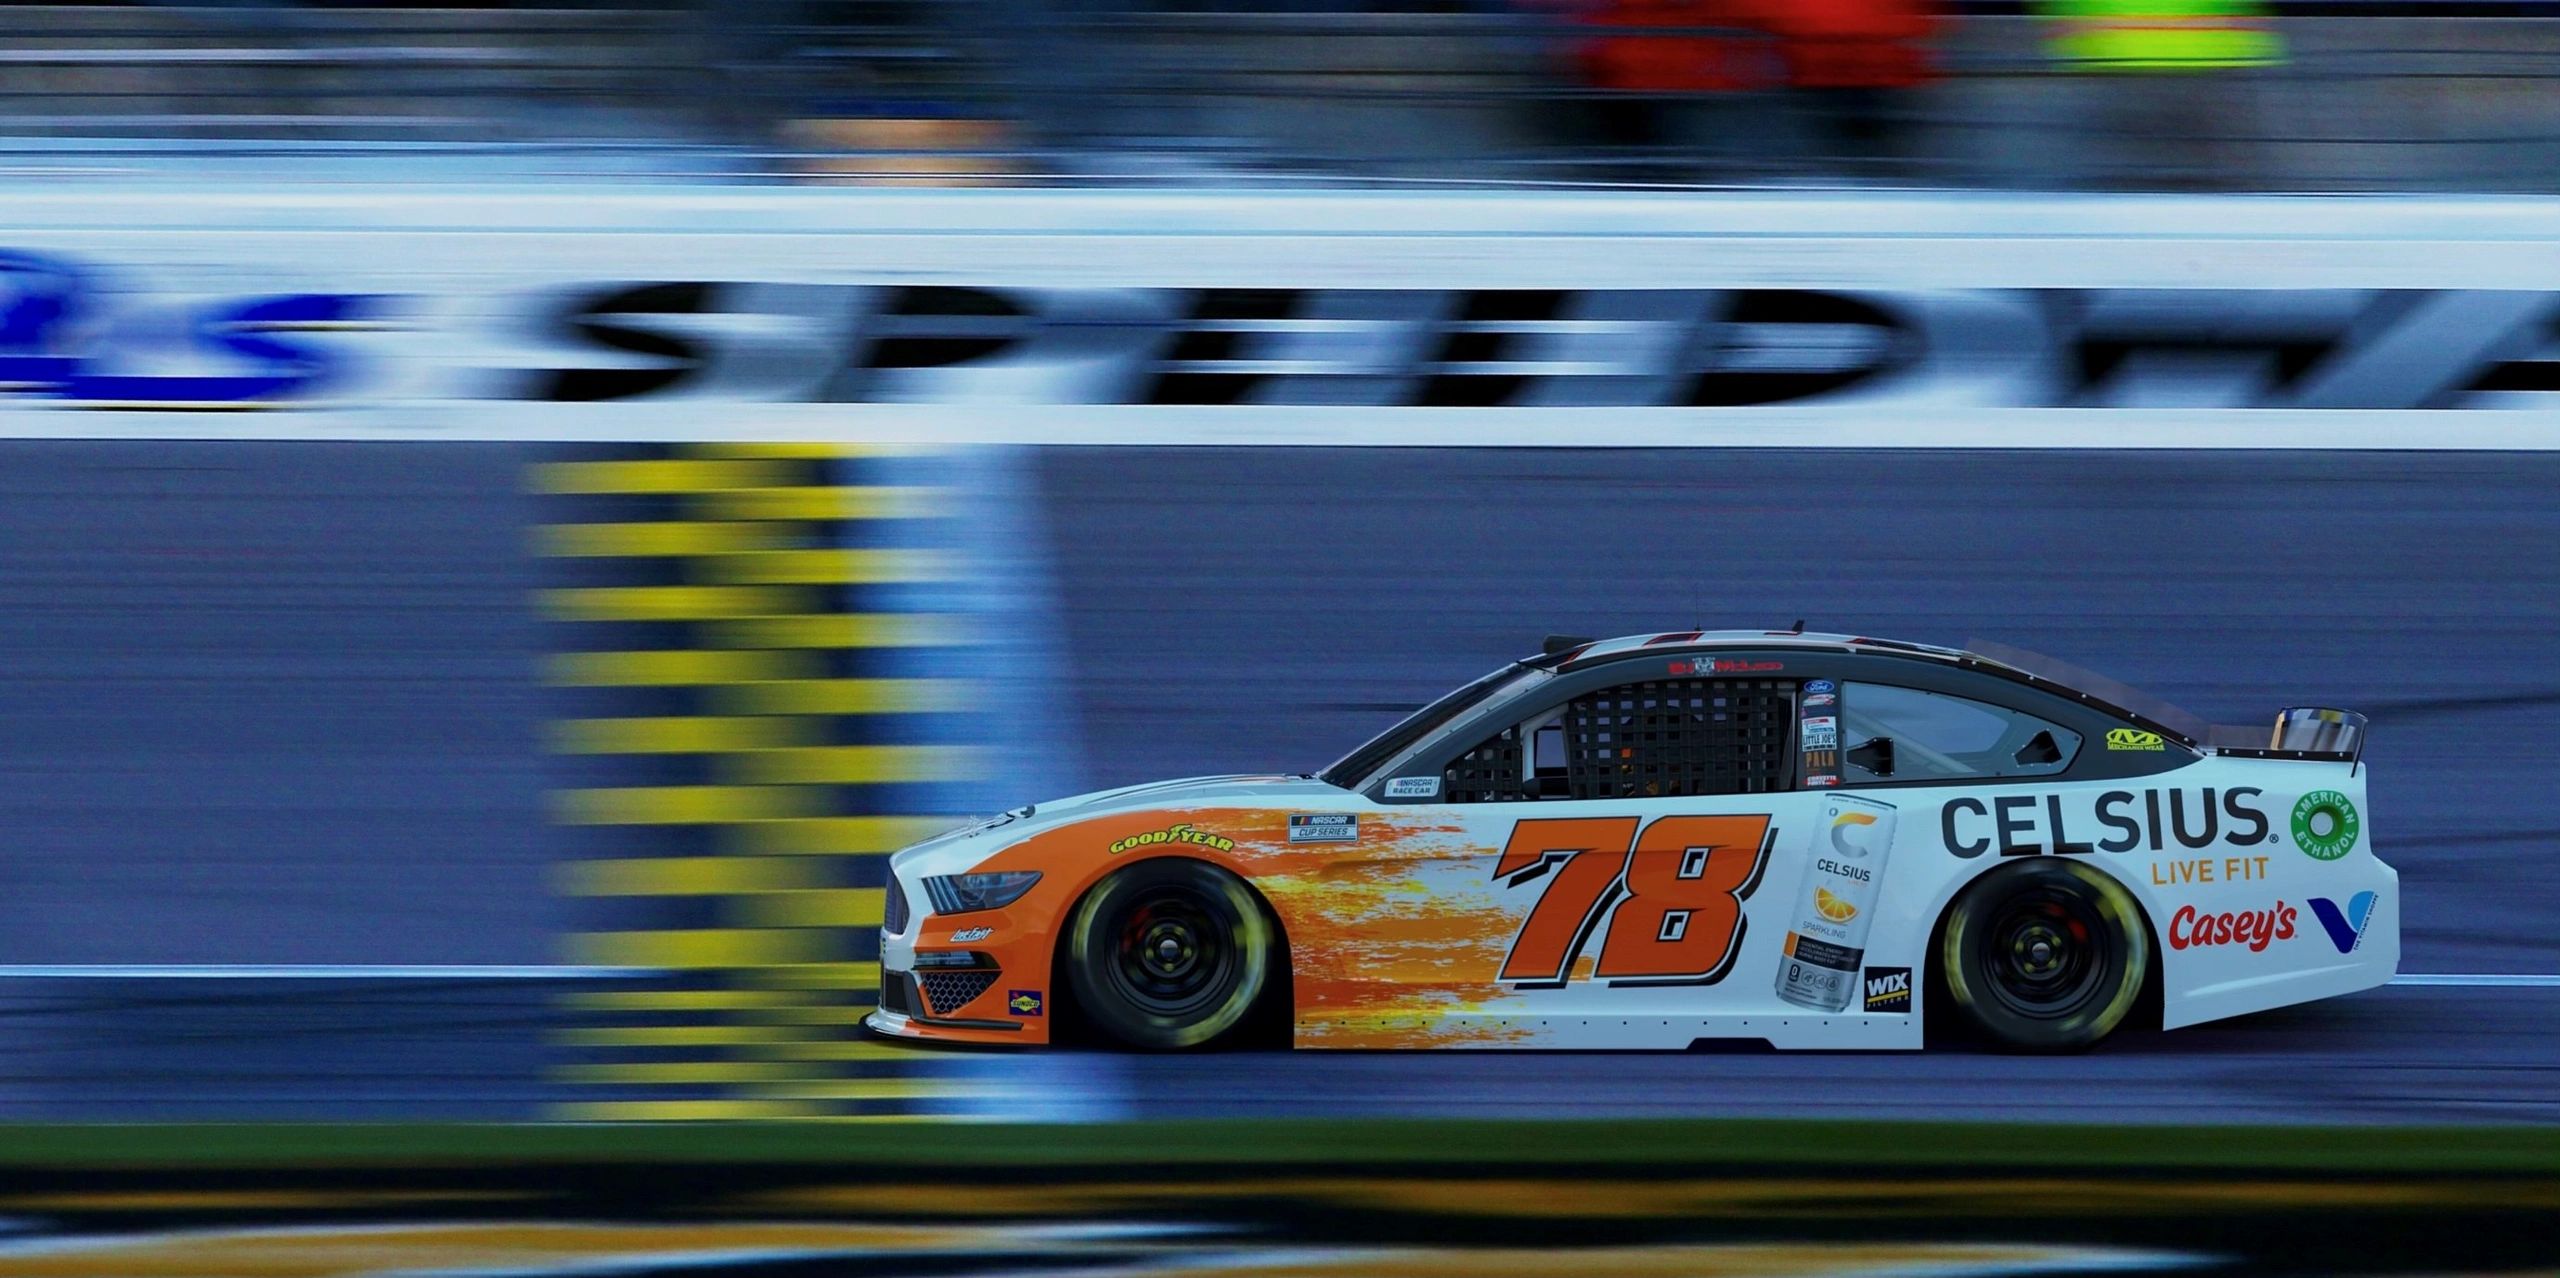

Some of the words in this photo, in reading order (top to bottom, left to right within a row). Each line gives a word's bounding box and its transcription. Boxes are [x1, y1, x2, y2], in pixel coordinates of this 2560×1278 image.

[1803, 734, 1820, 746] LITTLE
[1806, 751, 1834, 768] PALA
[1401, 779, 1433, 787] NASCAR
[2295, 791, 2356, 824] AMERICAN
[1299, 828, 1317, 837] CUP
[1317, 827, 1348, 836] SERIES
[1311, 816, 1348, 825] NASCAR
[1941, 786, 2270, 859] CELSIUS
[2296, 831, 2355, 857] ETHANOL
[1817, 858, 1871, 882] CELSIUS
[2152, 859, 2214, 886] LIVE
[2225, 856, 2270, 882] FIT
[1492, 813, 1779, 990] 78
[1802, 920, 1847, 939] SPARKLING
[2169, 899, 2297, 953] Casey's
[1867, 971, 1910, 997] WIX
